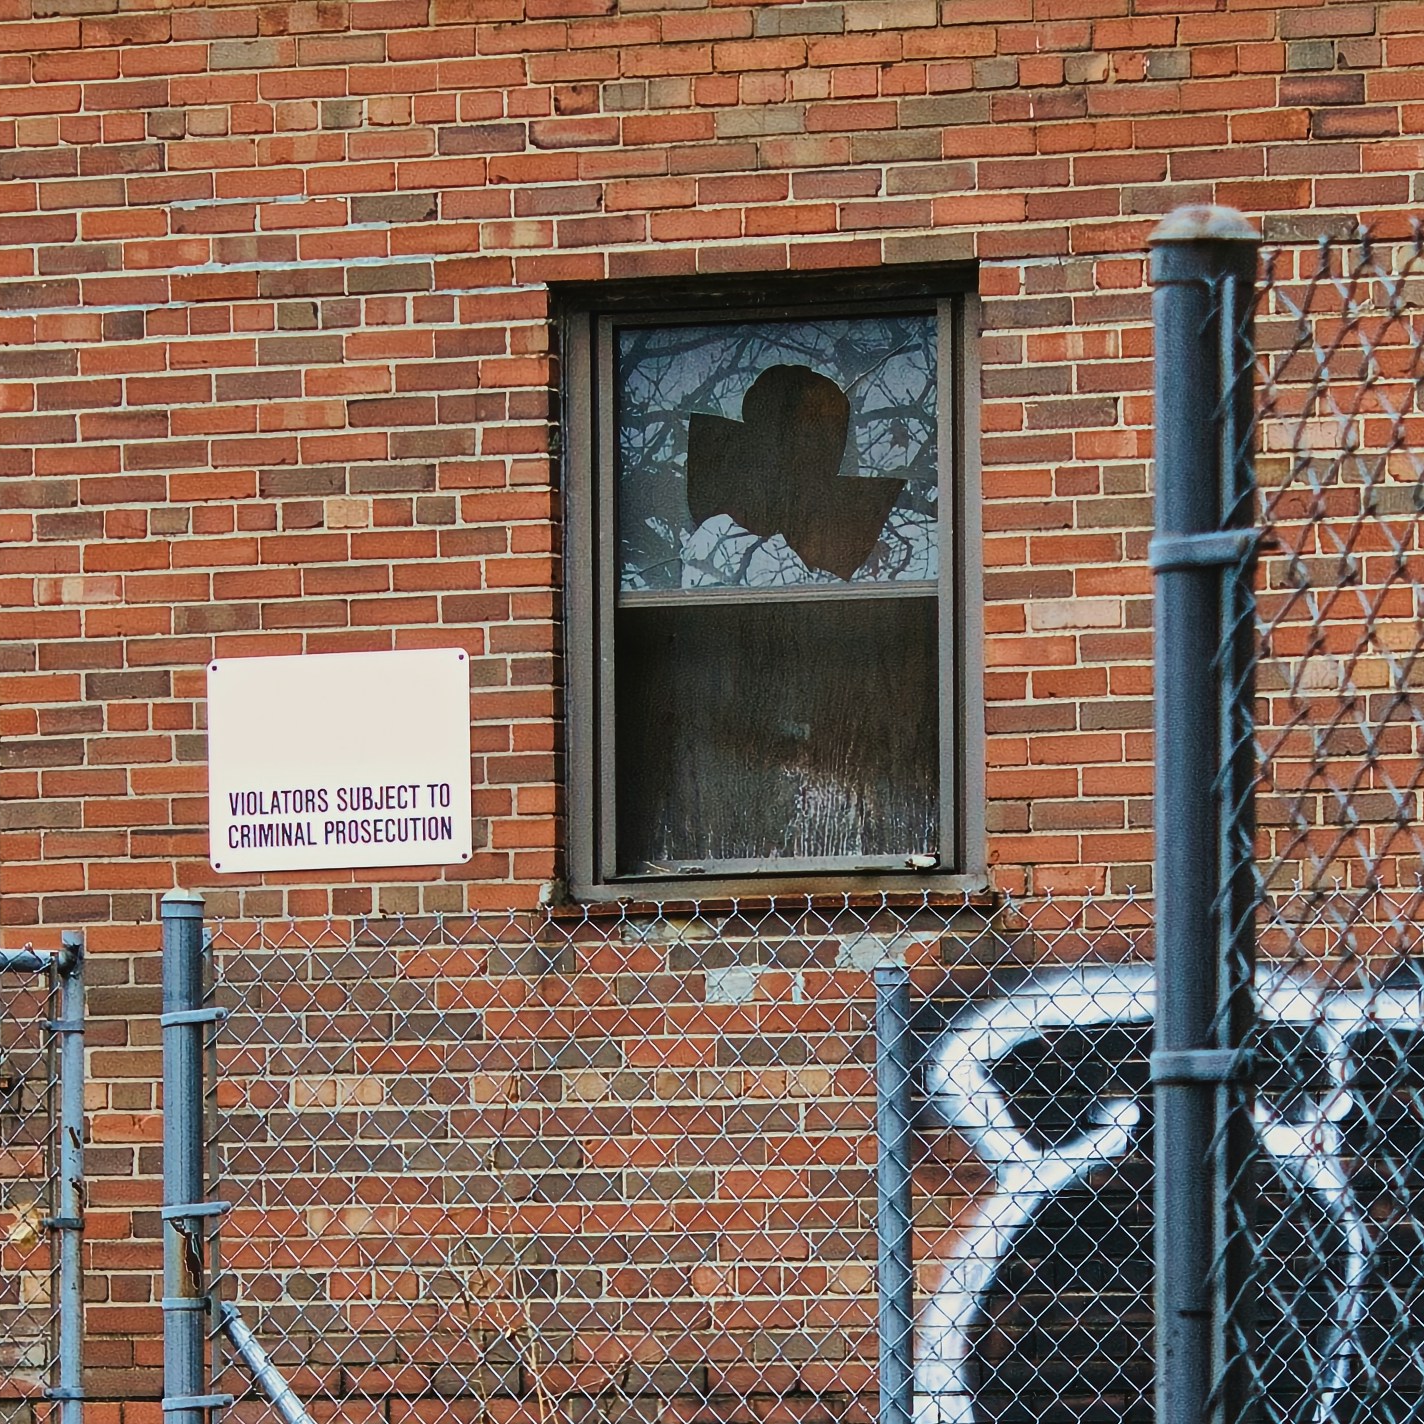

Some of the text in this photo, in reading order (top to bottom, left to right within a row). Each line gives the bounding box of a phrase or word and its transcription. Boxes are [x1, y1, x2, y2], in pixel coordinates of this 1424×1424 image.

[229, 783, 450, 816] VIOLATORS SUBJECT TO
[228, 816, 452, 849] CRIMINAL PROSECUTION
